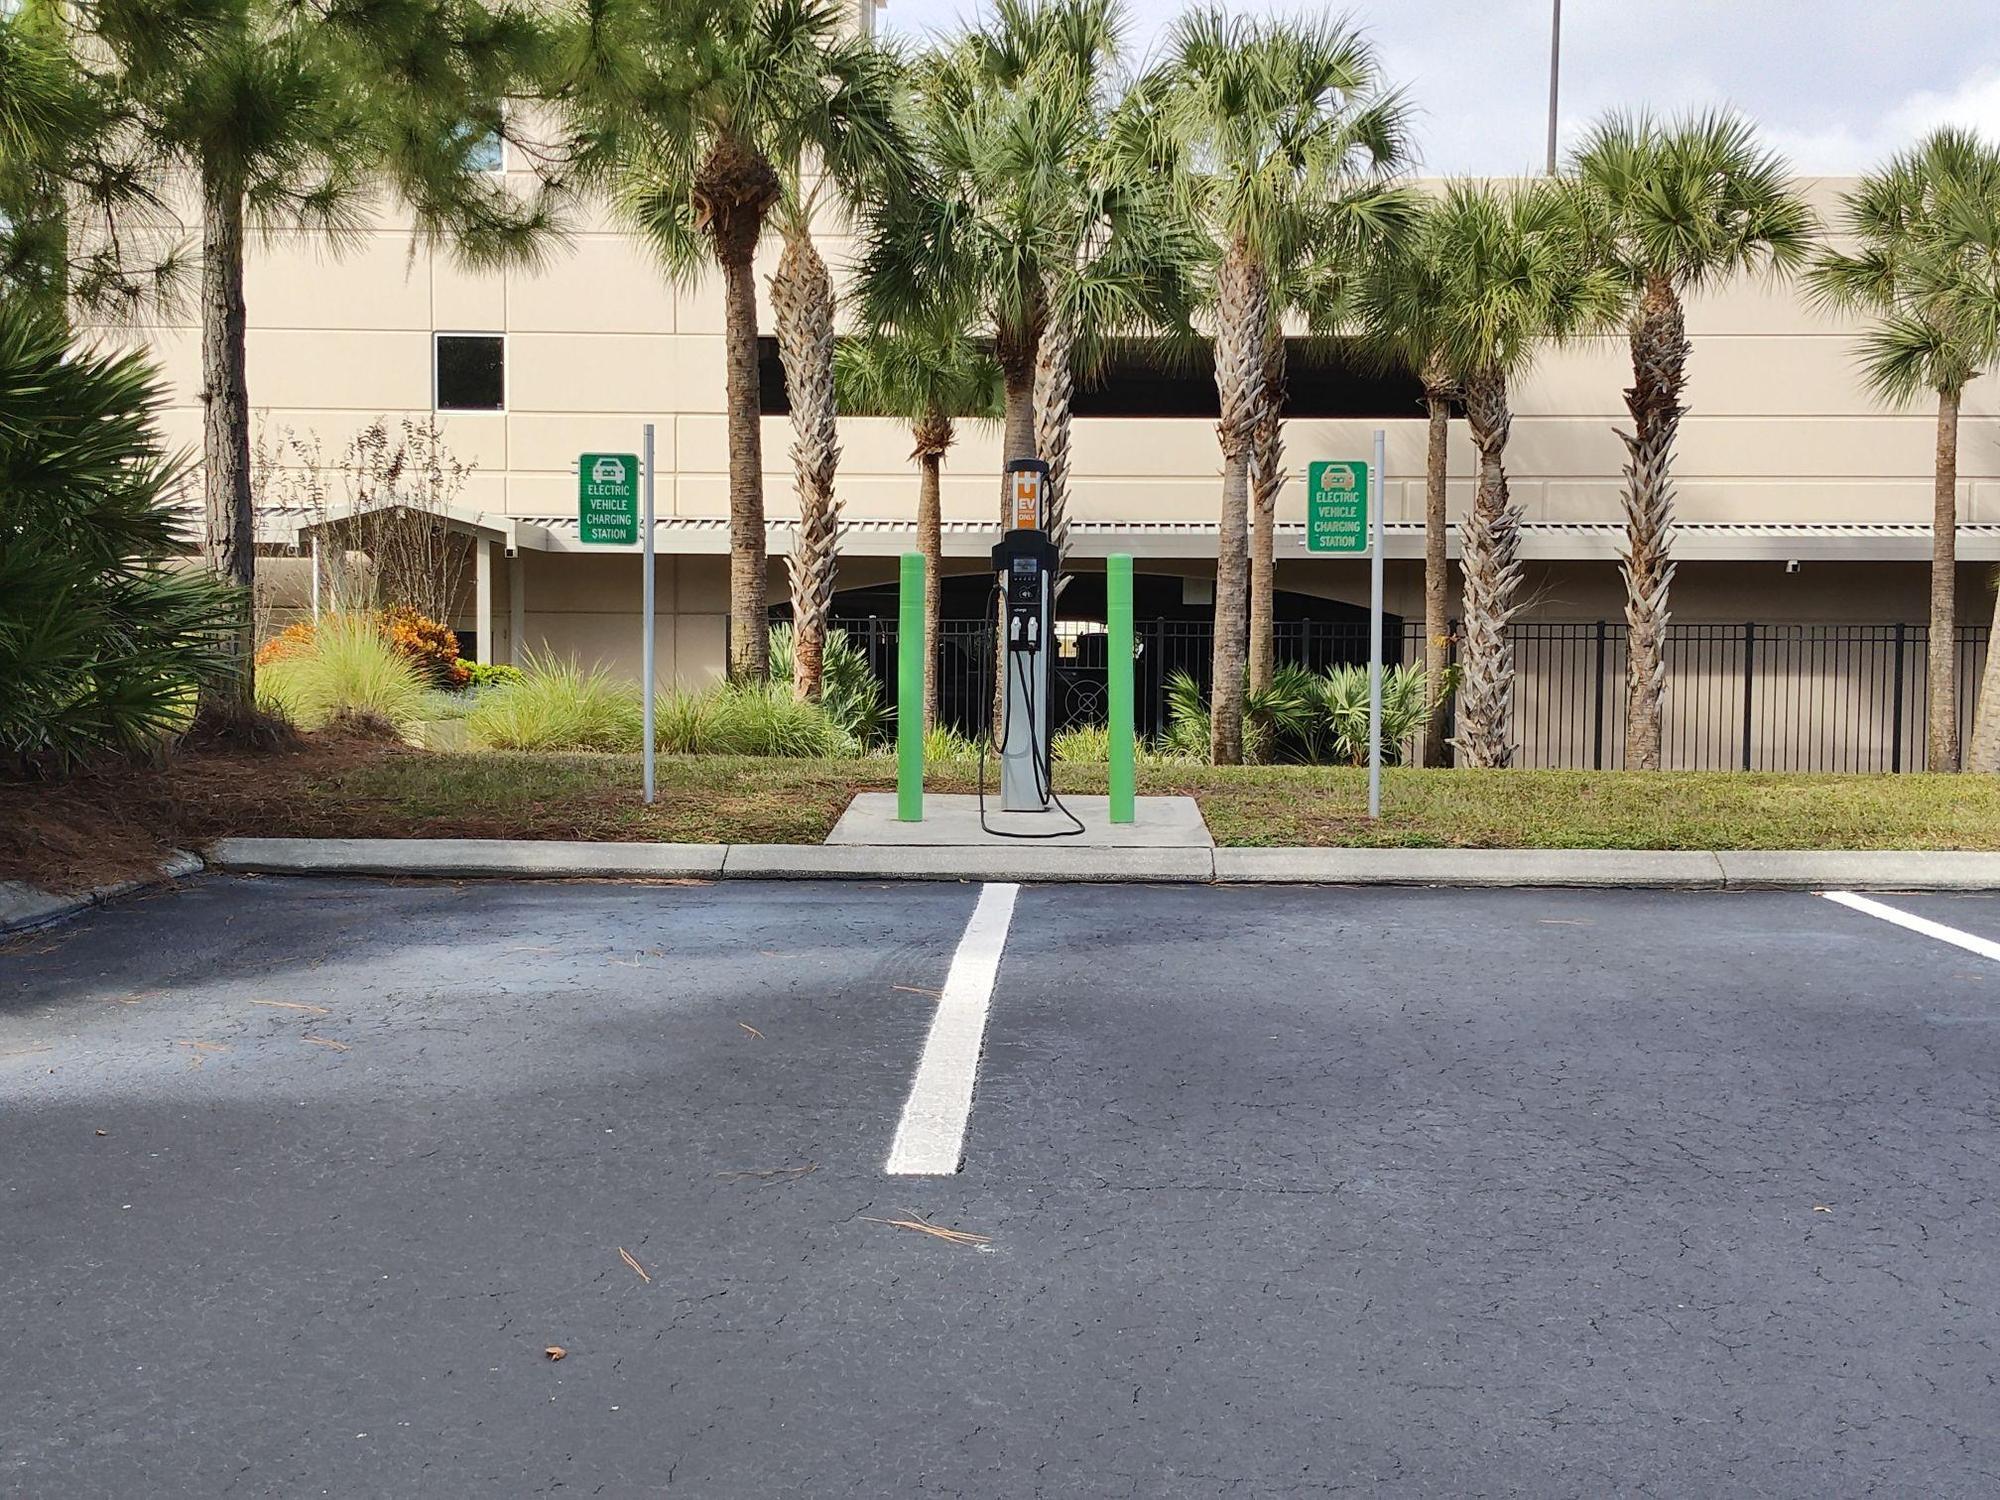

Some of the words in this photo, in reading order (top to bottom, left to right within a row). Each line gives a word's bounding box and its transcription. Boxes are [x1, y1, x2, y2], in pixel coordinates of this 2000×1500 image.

[588, 484, 630, 496] ELECTRIC
[1316, 491, 1360, 503] ELECTRIC
[590, 499, 628, 511] VEHICLE
[1018, 498, 1036, 510] EV
[1318, 506, 1357, 518] VEHICLE
[586, 513, 632, 525] CHARGING
[1314, 521, 1361, 533] CHARGING
[591, 528, 627, 540] STATION
[1319, 536, 1356, 547] STATION
